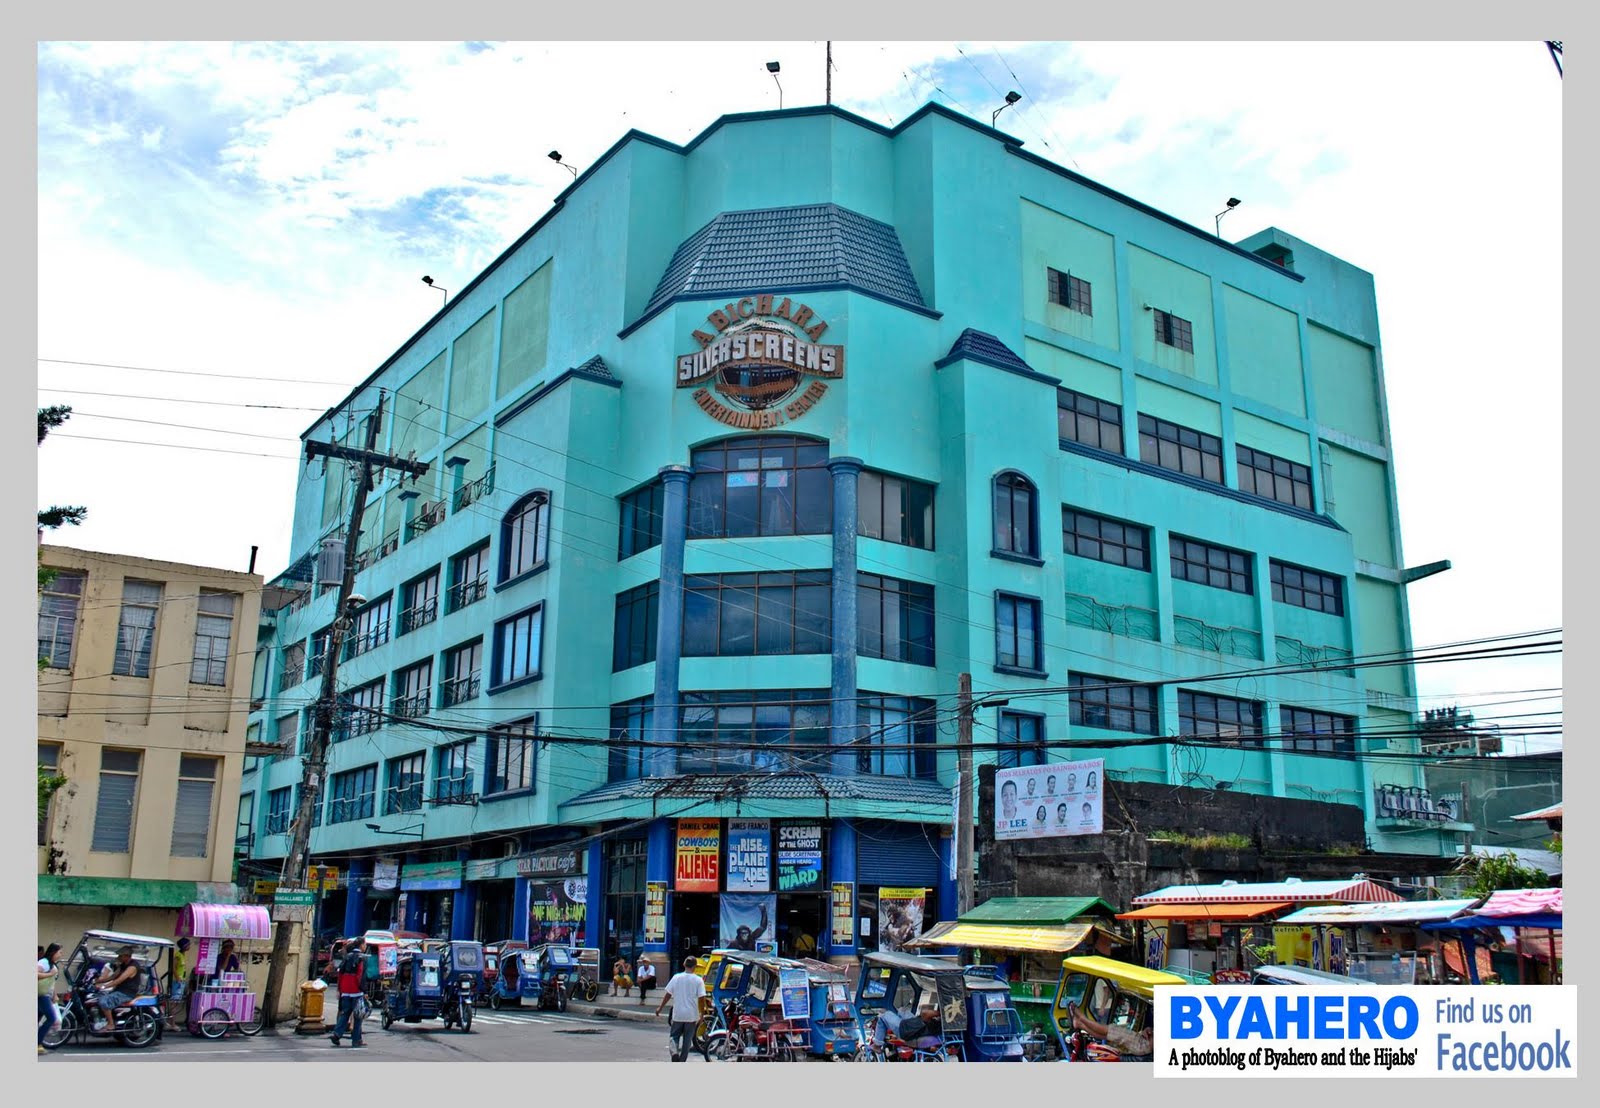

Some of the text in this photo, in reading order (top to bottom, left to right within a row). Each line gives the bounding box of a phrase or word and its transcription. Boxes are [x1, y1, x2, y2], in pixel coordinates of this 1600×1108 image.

[692, 293, 829, 349] A BICHARA
[679, 333, 837, 381] SILVERSCREENS
[692, 379, 829, 430] ENTERTAINMENT CENTER
[730, 822, 768, 830] JAMES FRANCO
[1010, 818, 1028, 828] LEE
[780, 827, 821, 840] SCREAM
[678, 837, 719, 847] COWBOYS
[740, 838, 763, 852] RISE
[797, 839, 819, 848] GHOST
[531, 856, 558, 872] FACTORY
[729, 845, 768, 873] PLANET
[677, 855, 718, 880] ALIENS
[779, 866, 795, 874] THE
[779, 869, 818, 890] WARD
